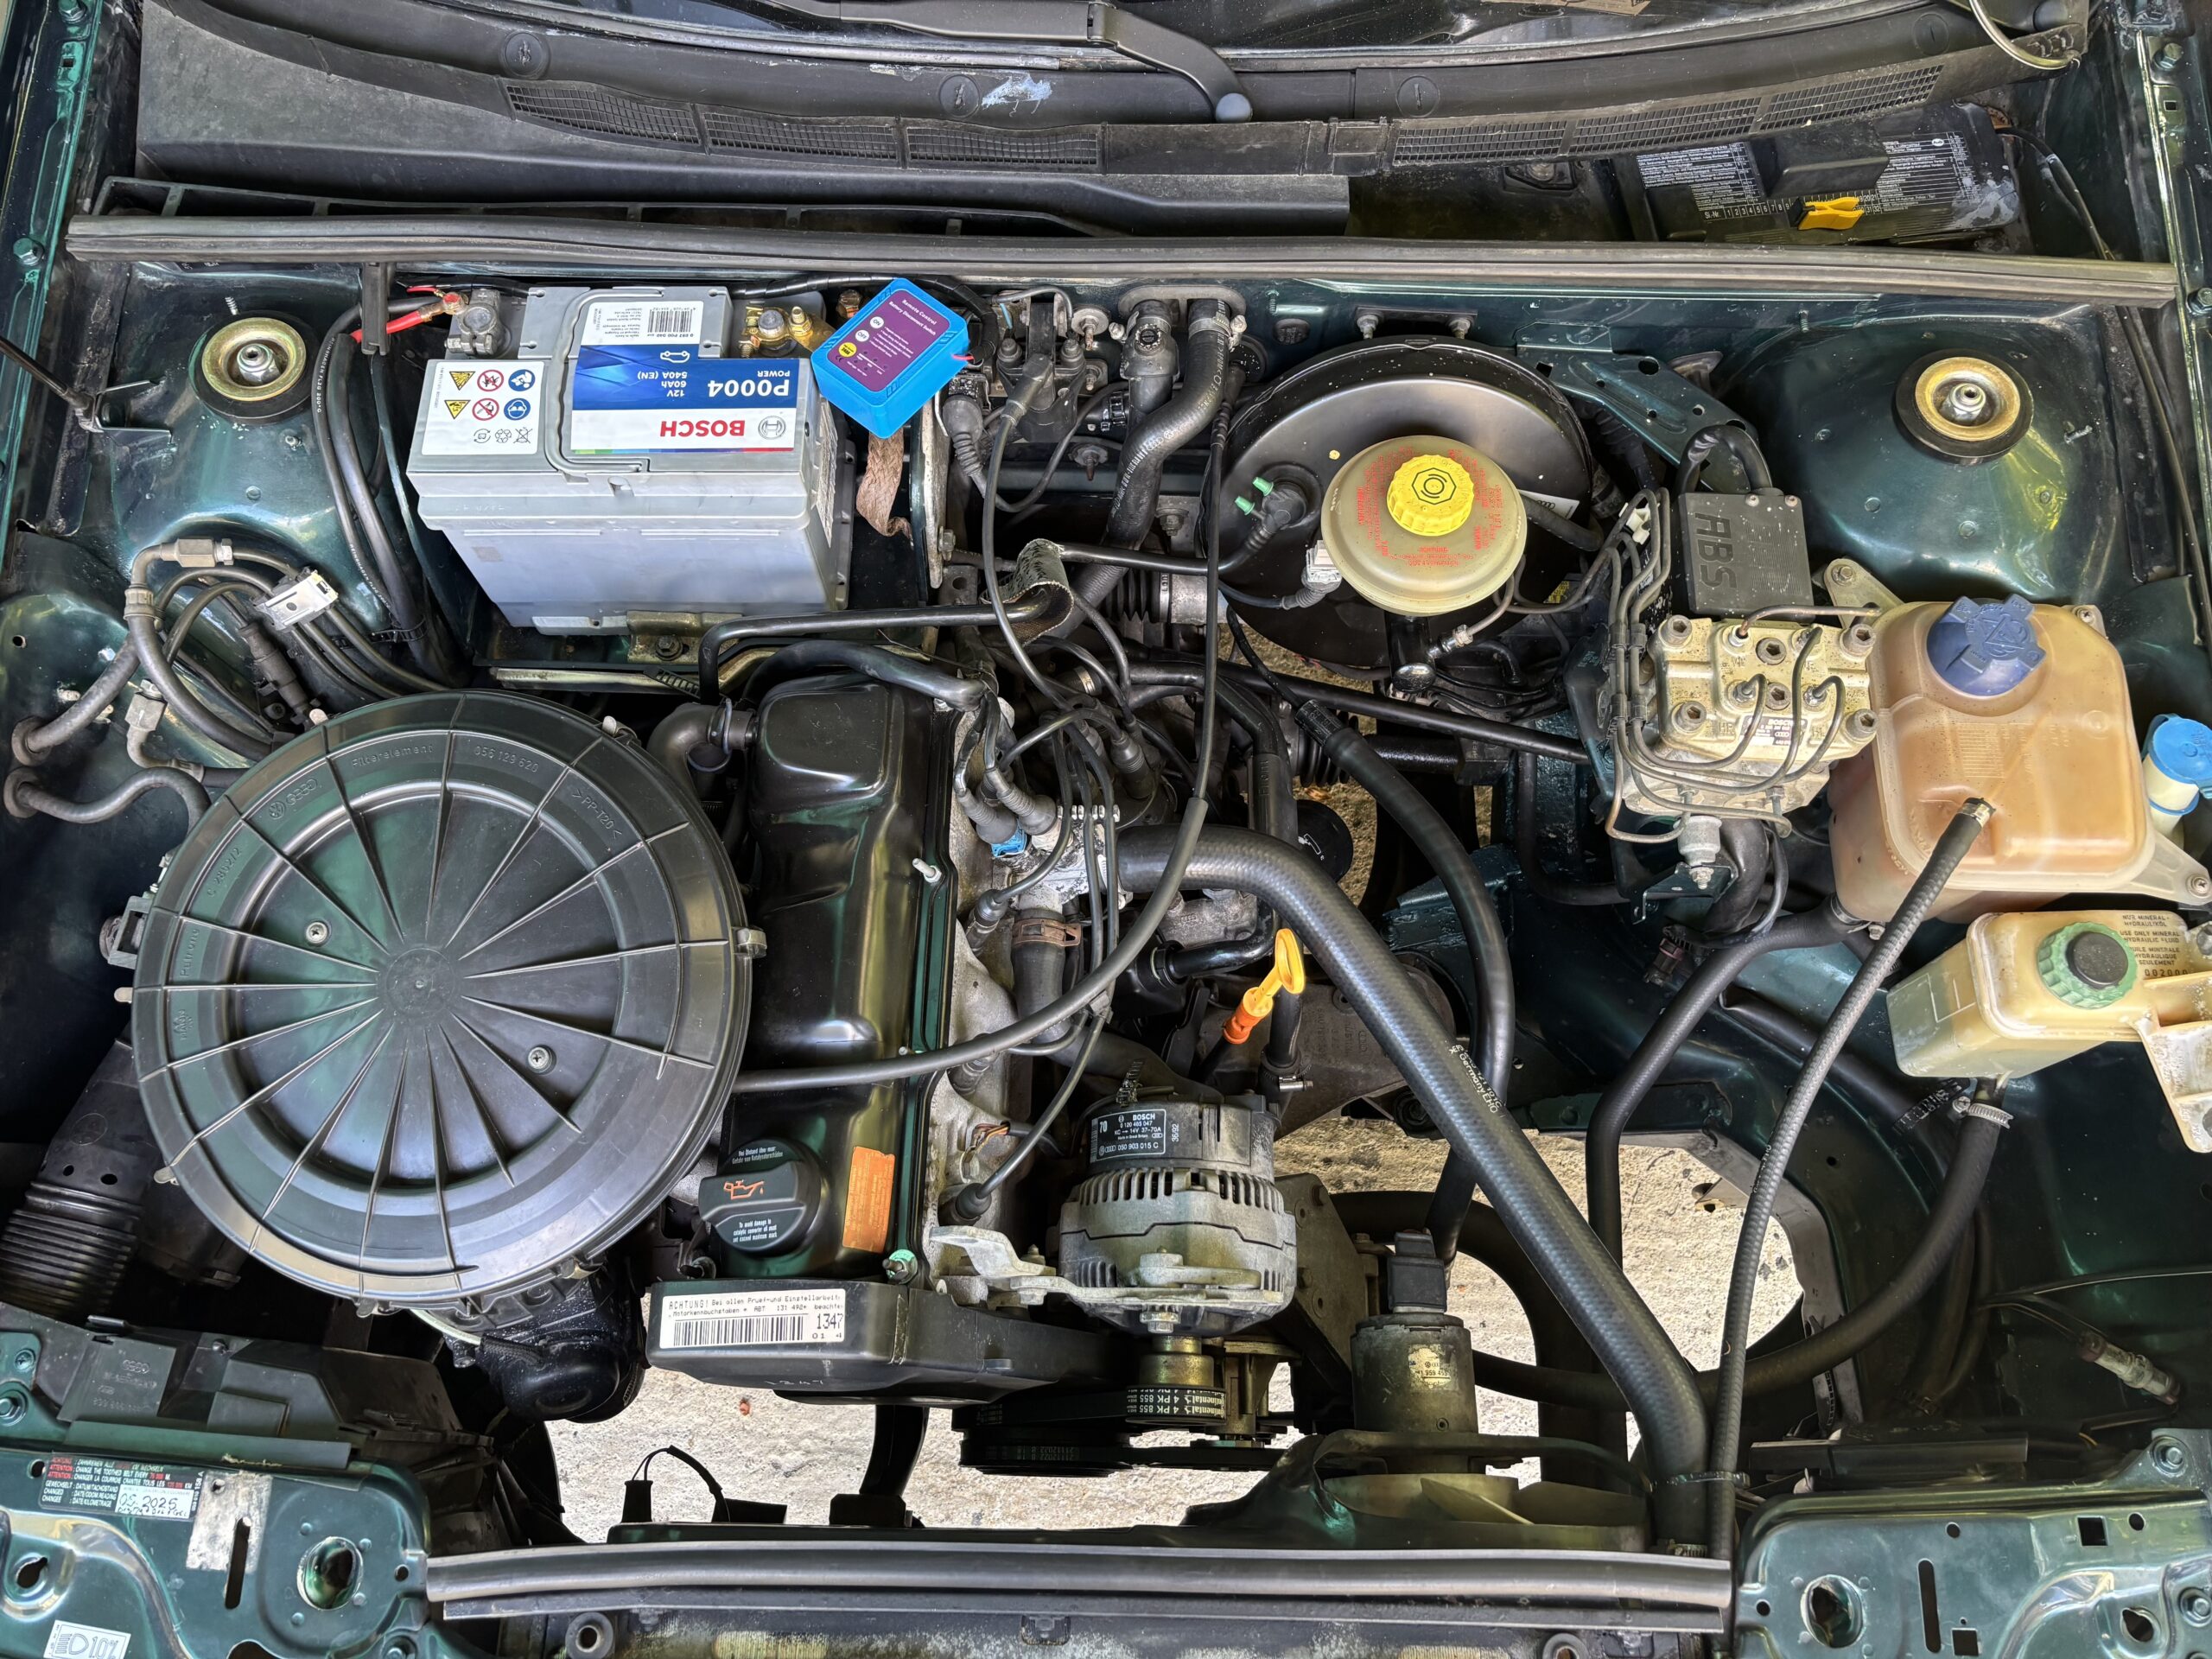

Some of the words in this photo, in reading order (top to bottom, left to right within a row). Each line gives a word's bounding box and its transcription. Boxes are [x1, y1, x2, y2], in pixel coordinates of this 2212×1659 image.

[888, 301, 903, 314] Battery
[901, 310, 924, 327] Disconnect
[922, 324, 936, 335] Switch
[901, 299, 919, 315] Remote
[918, 310, 937, 325] Control
[856, 331, 868, 340] OFF
[638, 371, 659, 379] (EN)
[708, 379, 789, 397] P0004
[660, 420, 745, 437] BOSCH
[1695, 512, 1737, 588] ABS
[352, 743, 434, 768] Filterelement
[1456, 1052, 1486, 1095] Germany
[1481, 1092, 1498, 1114] EHO
[1099, 1121, 1107, 1132] 70
[1171, 1123, 1179, 1142] 36/92
[668, 1299, 709, 1309] ACHTUNG!
[672, 1307, 740, 1316] Motorkennbuchstaben
[816, 1312, 843, 1330] 1347
[1156, 1394, 1170, 1402] PK
[47, 1470, 72, 1478] ATTENTION
[73, 1472, 93, 1481] CHANGER
[48, 1463, 73, 1472] ATTENTION
[103, 1467, 122, 1476] TOOTHED
[43, 1487, 64, 1496] CHANGED
